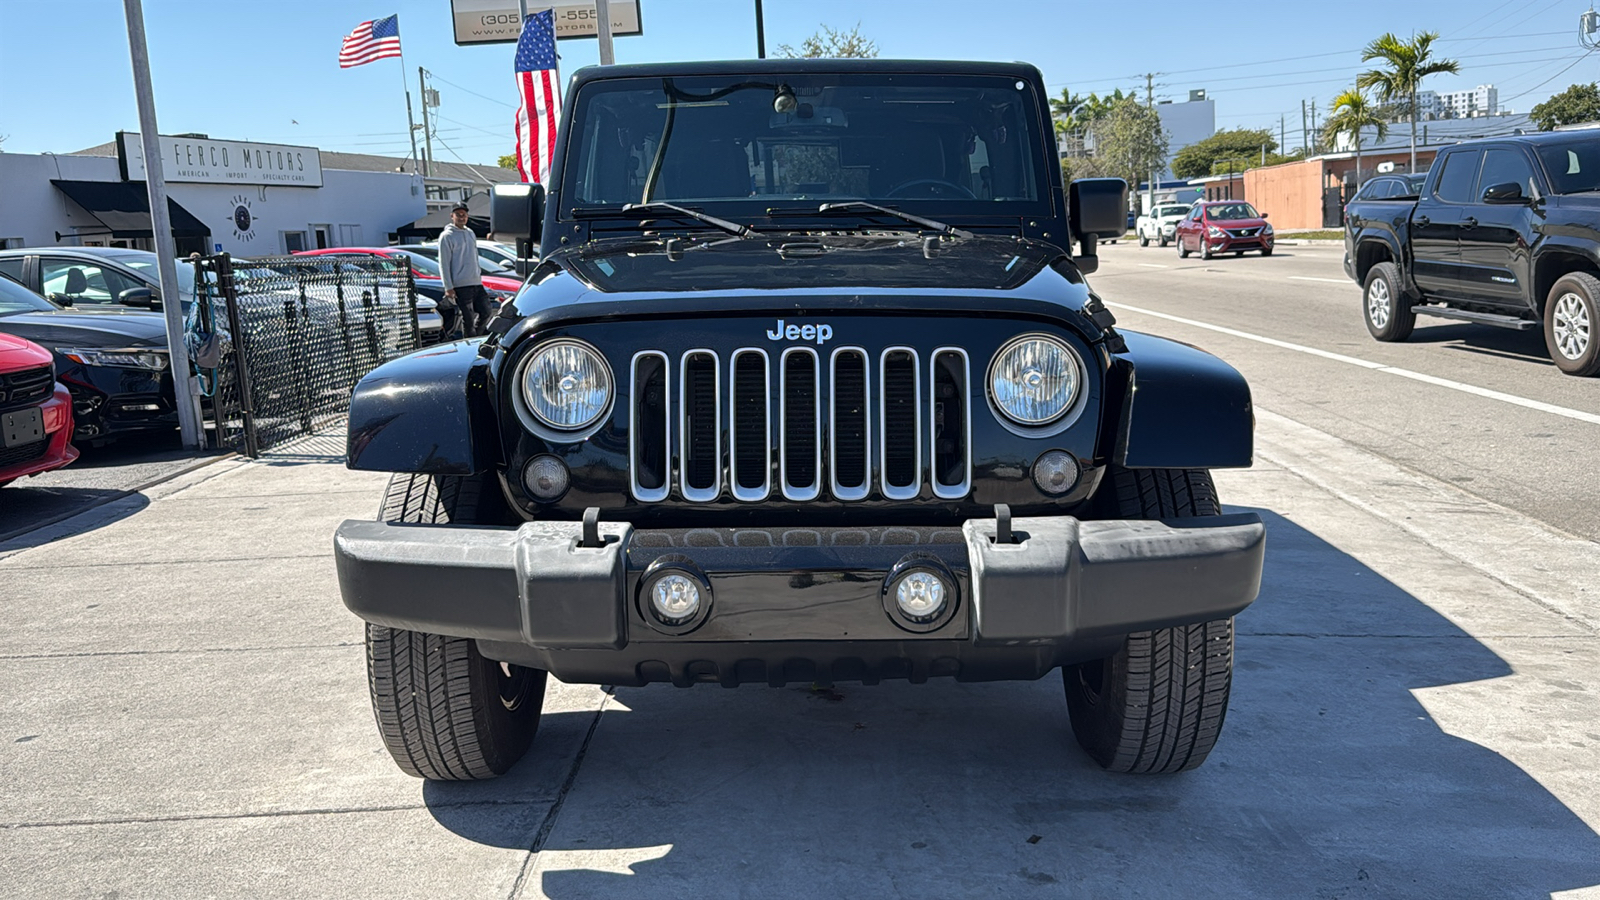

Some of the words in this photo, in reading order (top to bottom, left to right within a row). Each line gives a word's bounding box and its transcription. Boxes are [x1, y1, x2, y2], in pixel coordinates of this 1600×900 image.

[481, 14, 519, 26] (305
[174, 143, 230, 168] FERCO
[242, 148, 304, 172] MOTORS
[177, 169, 210, 178] AMERICAN
[262, 173, 290, 181] SPECIALTY
[766, 319, 833, 345] Jeep
